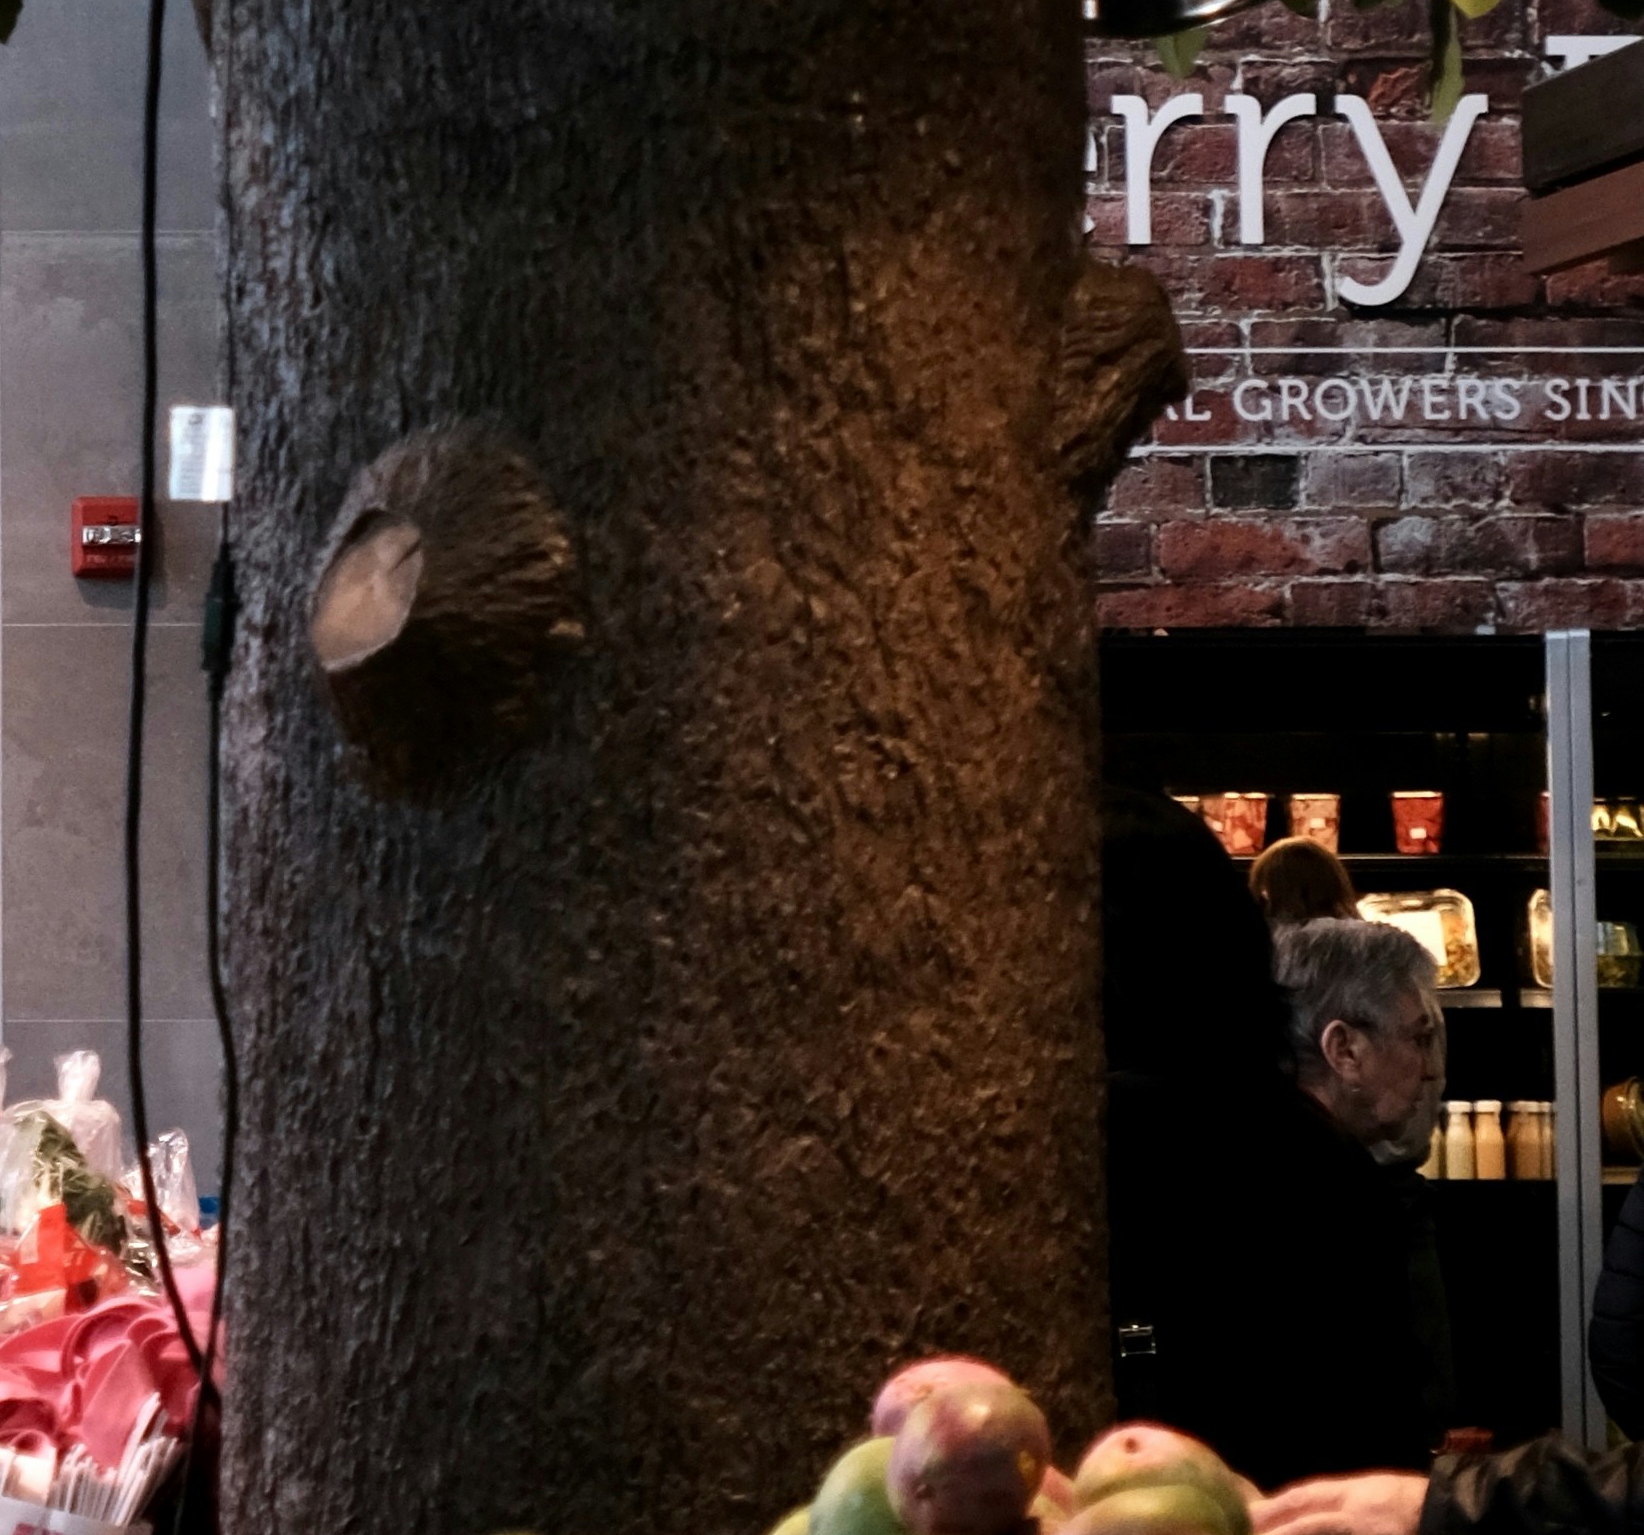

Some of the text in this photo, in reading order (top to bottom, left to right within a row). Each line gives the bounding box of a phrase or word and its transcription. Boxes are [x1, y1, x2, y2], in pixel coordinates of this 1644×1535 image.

[1084, 92, 1489, 307] rry
[1233, 379, 1523, 422] GROWERS
[1543, 379, 1644, 422] SIN
